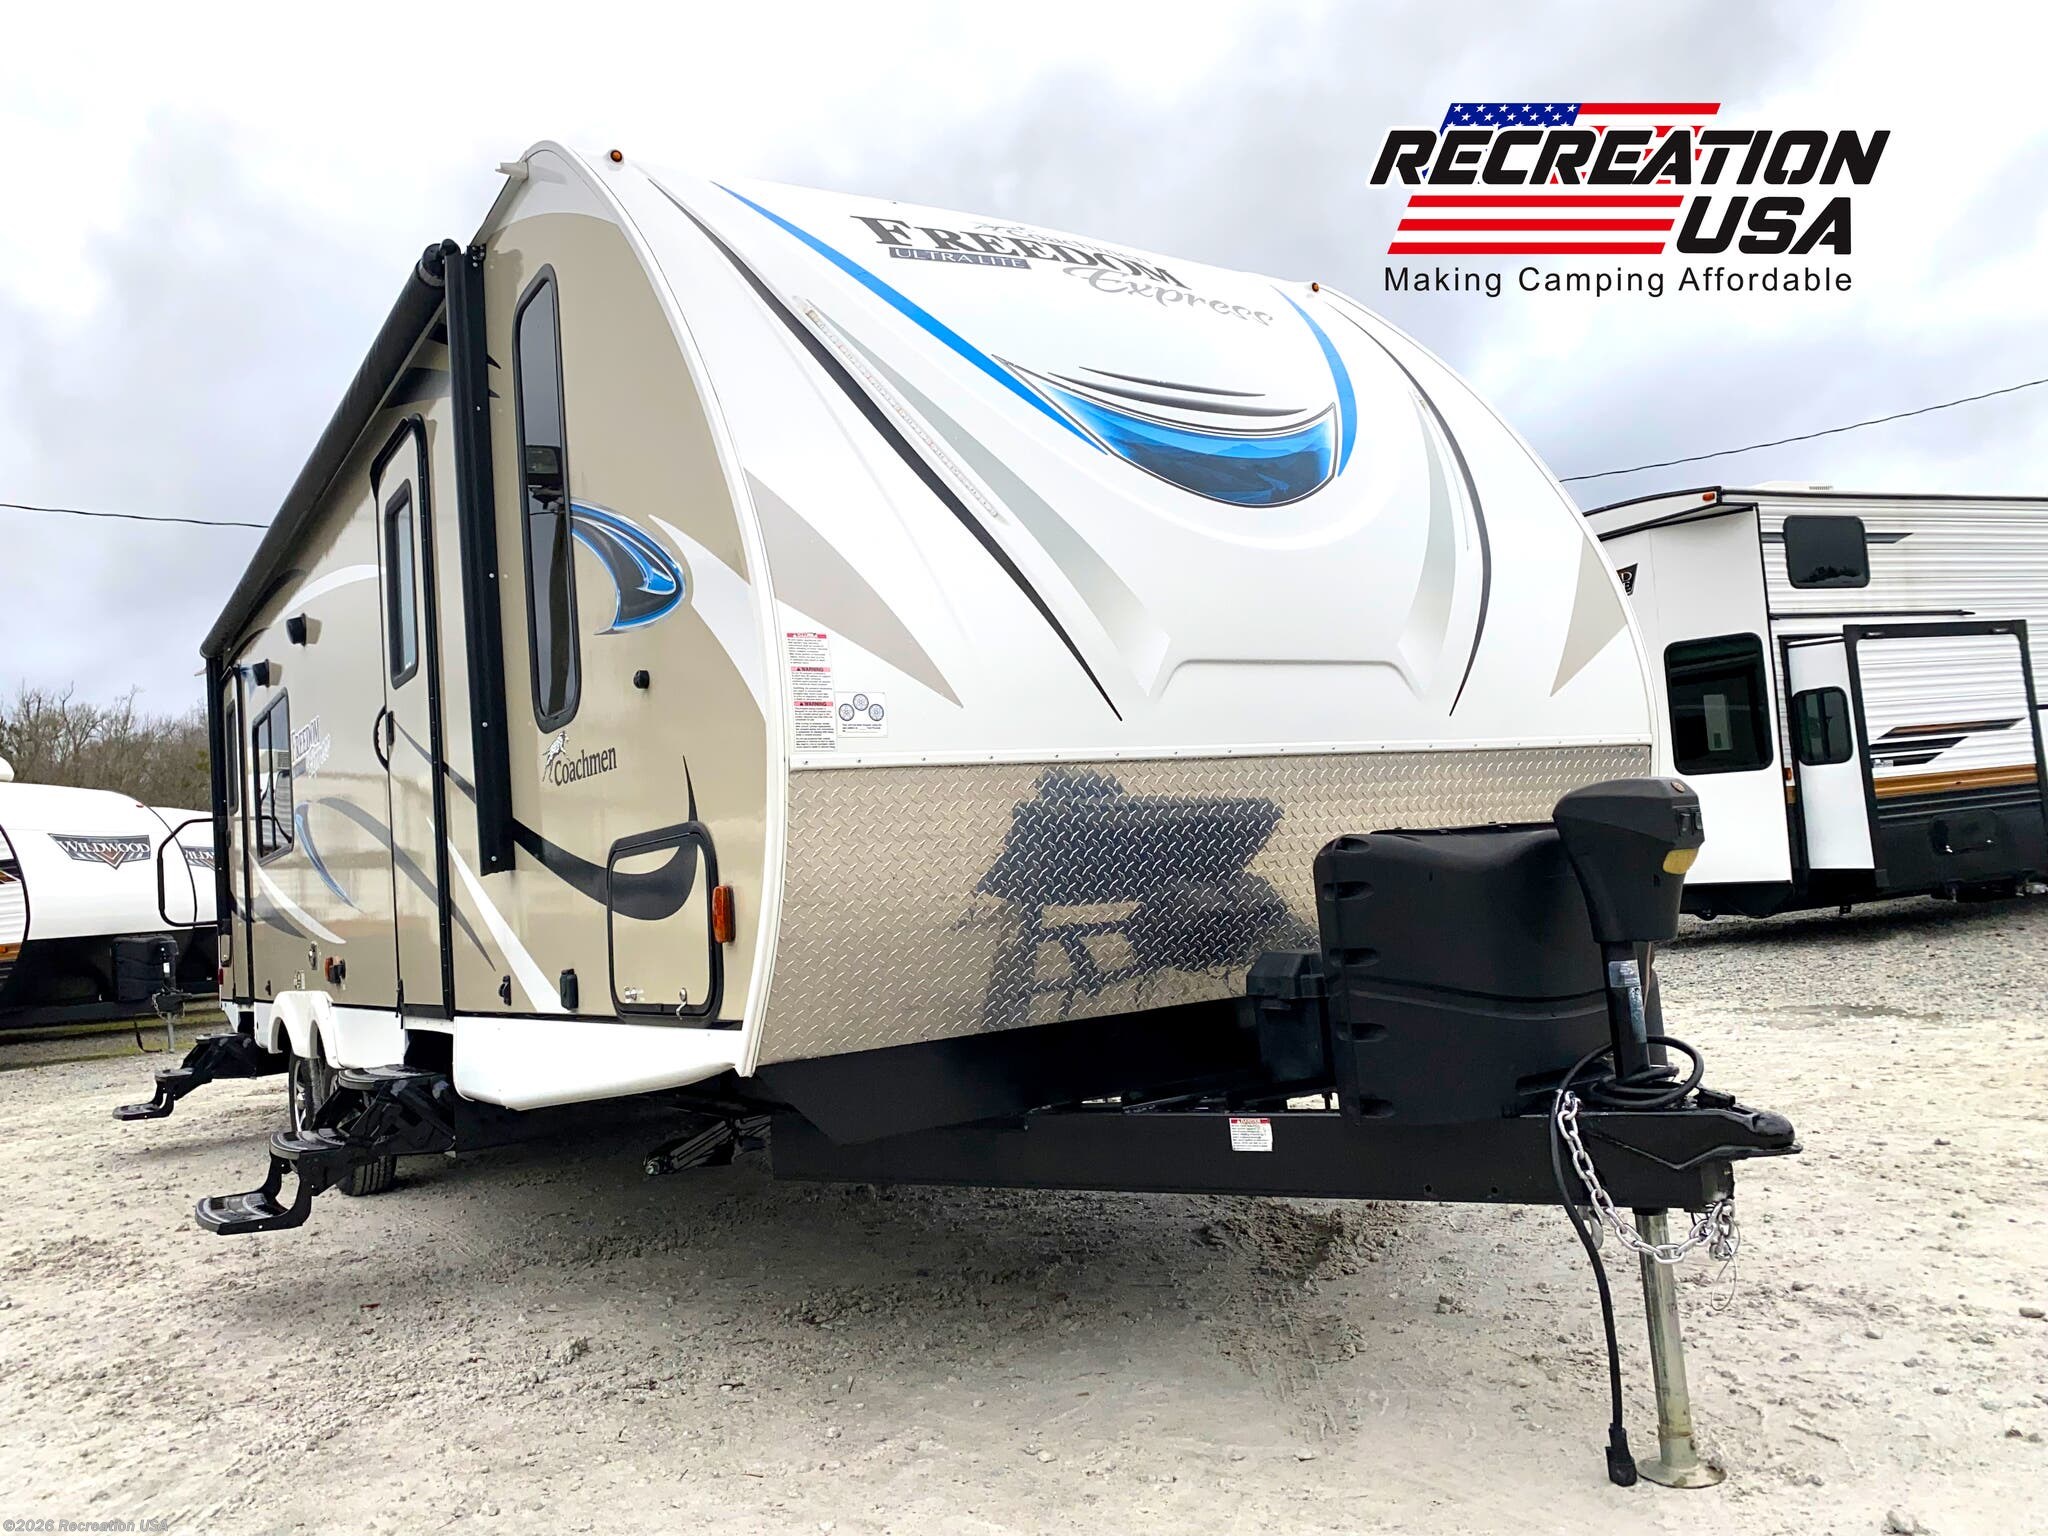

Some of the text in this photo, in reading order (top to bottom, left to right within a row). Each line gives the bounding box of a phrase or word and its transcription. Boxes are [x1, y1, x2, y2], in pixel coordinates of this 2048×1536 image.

[849, 215, 1192, 290] FREEDOM
[894, 248, 1027, 268] ULTRA LITE
[1062, 266, 1273, 326] Express
[554, 747, 617, 786] Coachmen
[56, 840, 151, 853] WILDWOOD
